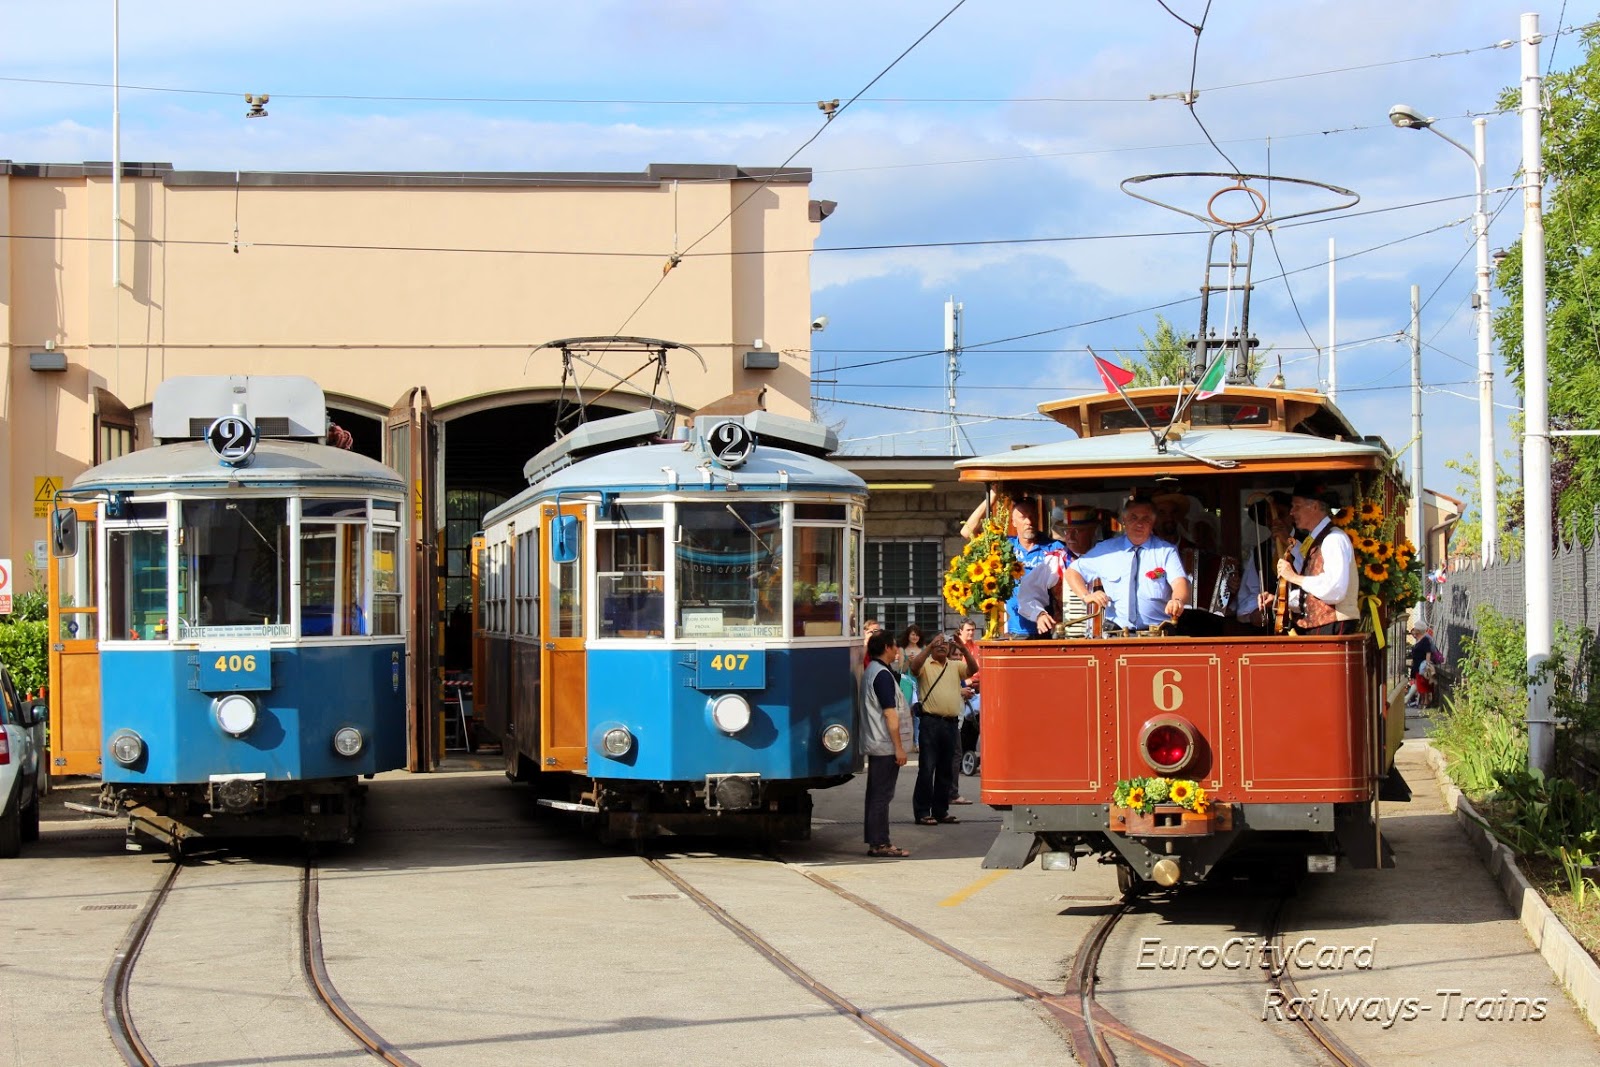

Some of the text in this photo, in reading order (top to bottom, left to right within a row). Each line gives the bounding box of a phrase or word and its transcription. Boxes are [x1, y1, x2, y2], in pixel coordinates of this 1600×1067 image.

[219, 419, 245, 456] 2
[718, 424, 743, 460] 2
[180, 627, 206, 638] TRIESTE
[753, 626, 782, 637] TRIESTE
[214, 655, 256, 672] 406
[710, 654, 749, 671] 407
[1152, 668, 1184, 712] 6
